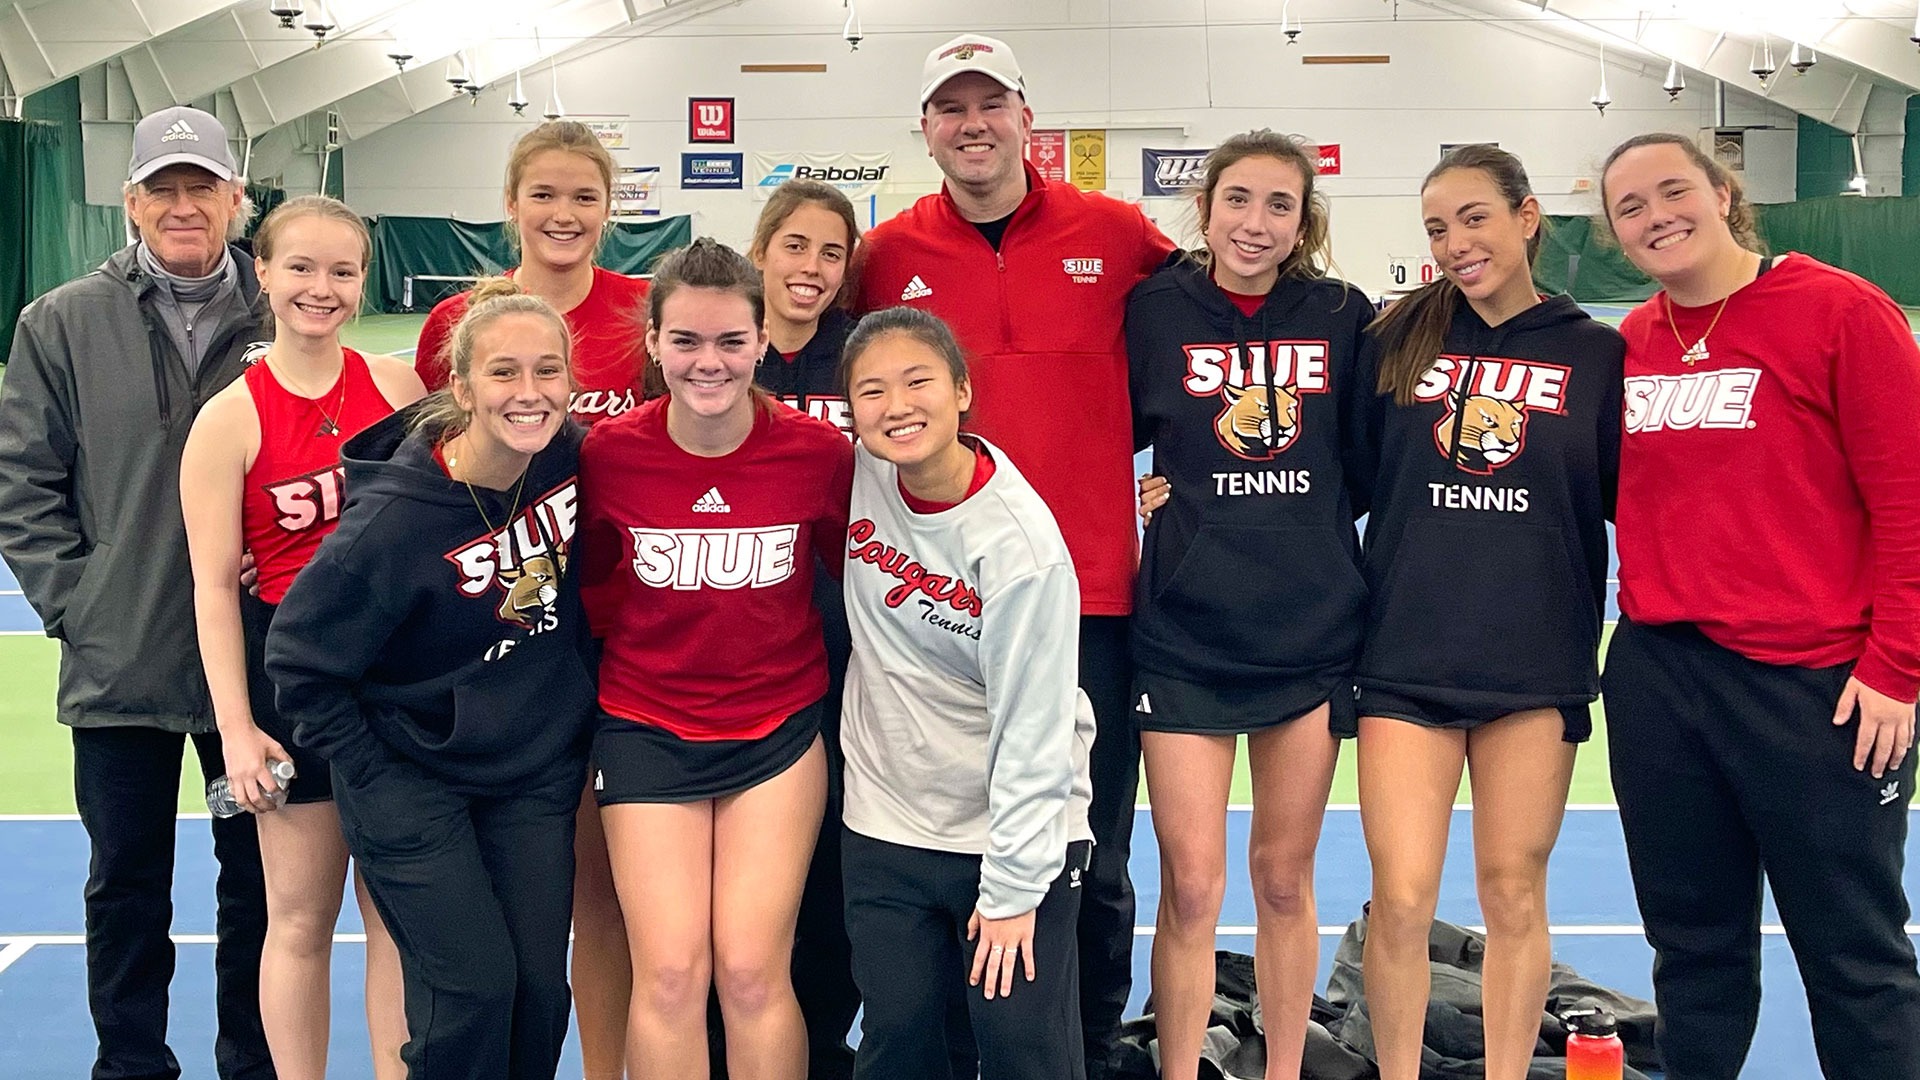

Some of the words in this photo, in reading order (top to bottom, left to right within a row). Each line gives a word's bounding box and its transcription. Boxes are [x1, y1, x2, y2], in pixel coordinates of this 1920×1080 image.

[161, 132, 200, 142] adidas
[697, 128, 726, 137] Wilson
[1064, 258, 1103, 274] SIUE
[1072, 275, 1097, 283] TENNIS
[1421, 264, 1432, 283] 0
[901, 288, 933, 301] adidas
[1183, 342, 1328, 395] SIUE
[1414, 356, 1570, 411] SIUE
[1624, 367, 1762, 434] SIUE
[1212, 470, 1310, 495] TENNIS
[266, 465, 346, 532] SI
[692, 503, 731, 513] adidas
[1428, 483, 1529, 512] TENNIS
[448, 479, 578, 596] SIUE
[628, 524, 799, 590] SIUE
[849, 519, 982, 617] Cougars
[918, 600, 982, 640] Tennis
